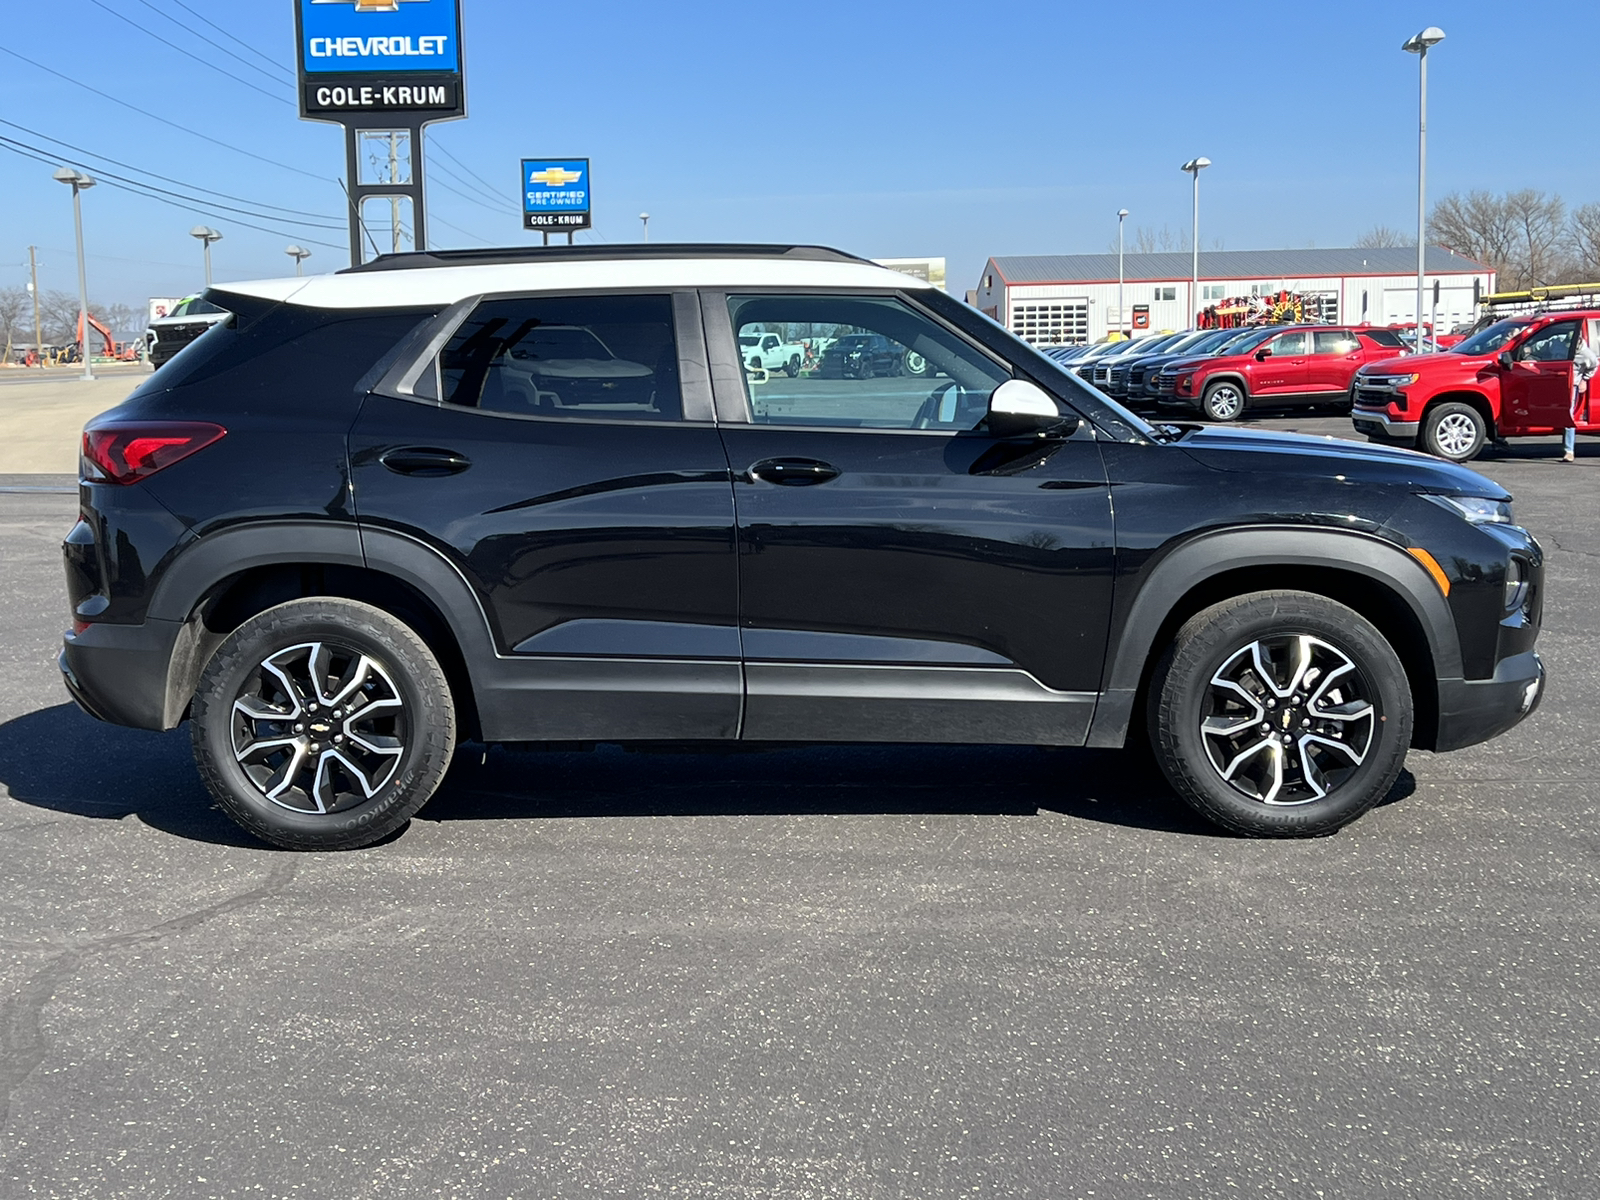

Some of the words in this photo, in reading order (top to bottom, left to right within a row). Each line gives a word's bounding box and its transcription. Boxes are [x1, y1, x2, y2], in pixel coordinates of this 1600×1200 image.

[310, 35, 448, 57] CHEVROLET
[316, 86, 445, 106] COLE-KRUM
[527, 190, 585, 199] CERTIFIED
[530, 215, 583, 225] COLE-KRUM
